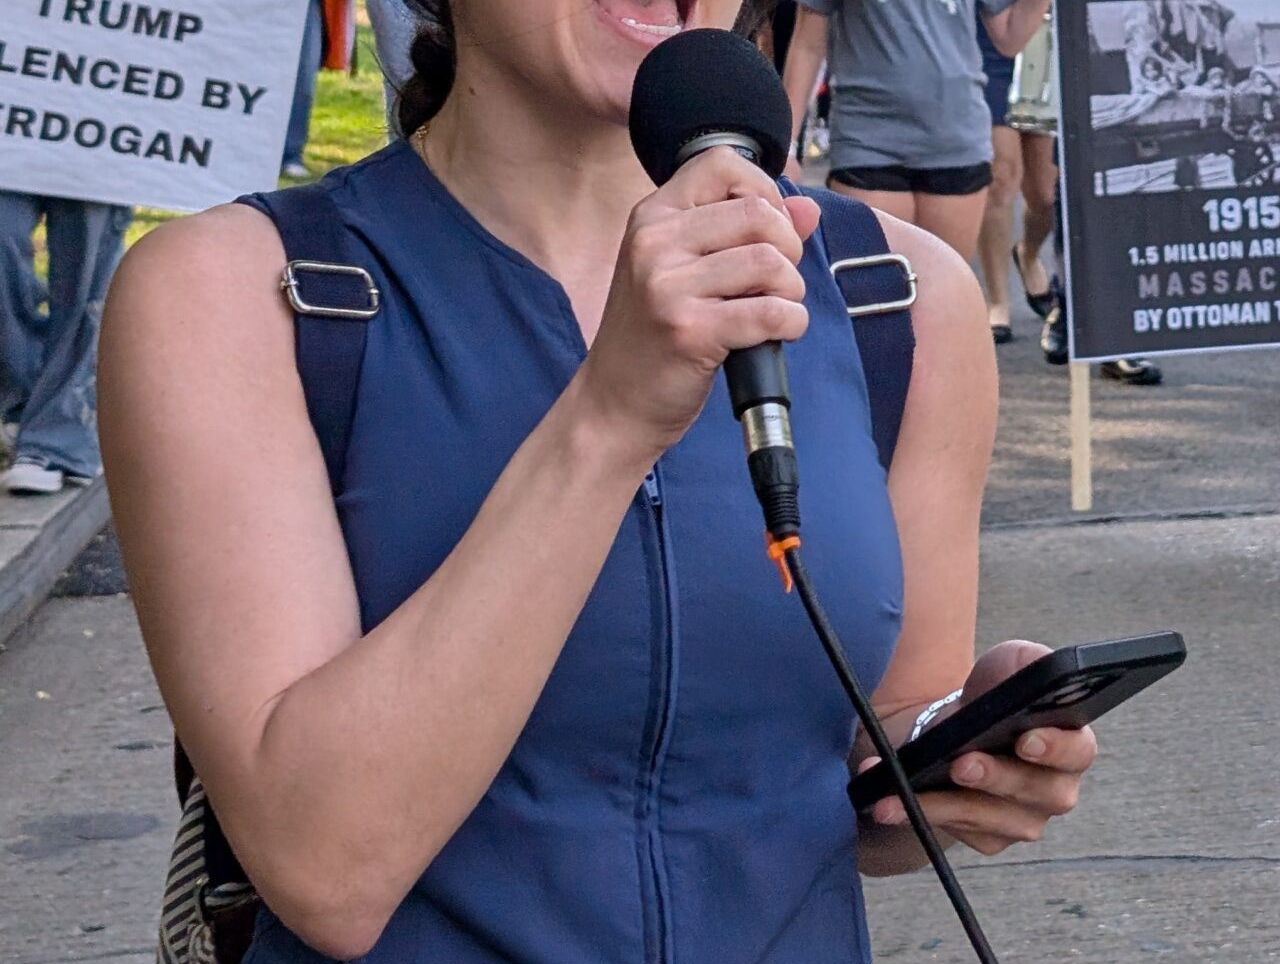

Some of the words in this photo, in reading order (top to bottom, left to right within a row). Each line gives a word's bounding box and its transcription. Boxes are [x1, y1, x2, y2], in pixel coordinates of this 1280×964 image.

[201, 78, 267, 115] BY
[0, 104, 213, 168] RDOGAN
[1128, 246, 1160, 266] 1.5
[1163, 240, 1244, 263] MILLION
[1133, 308, 1162, 333] BY
[1166, 302, 1271, 330] OTTOMAN
